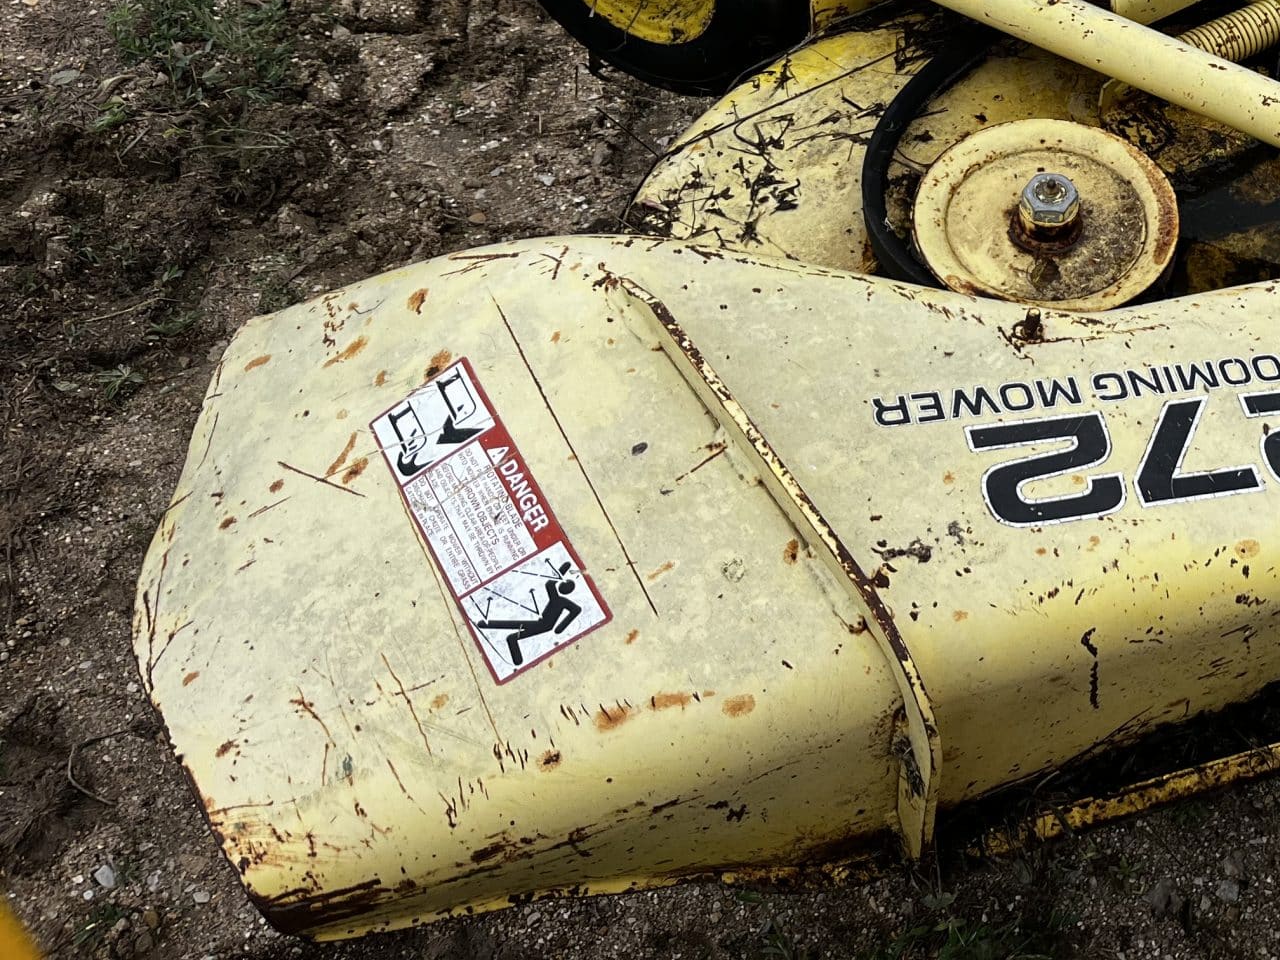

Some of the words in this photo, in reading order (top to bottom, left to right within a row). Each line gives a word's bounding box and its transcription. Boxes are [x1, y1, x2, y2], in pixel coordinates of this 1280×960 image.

[871, 375, 1079, 426] MOWER
[499, 457, 551, 532] DANGER
[503, 502, 523, 530] BLADE
[463, 506, 478, 526] CLEAR
[473, 524, 485, 541] AREA
[486, 547, 502, 571] PEOPLE
[476, 509, 500, 546] OBJECTS
